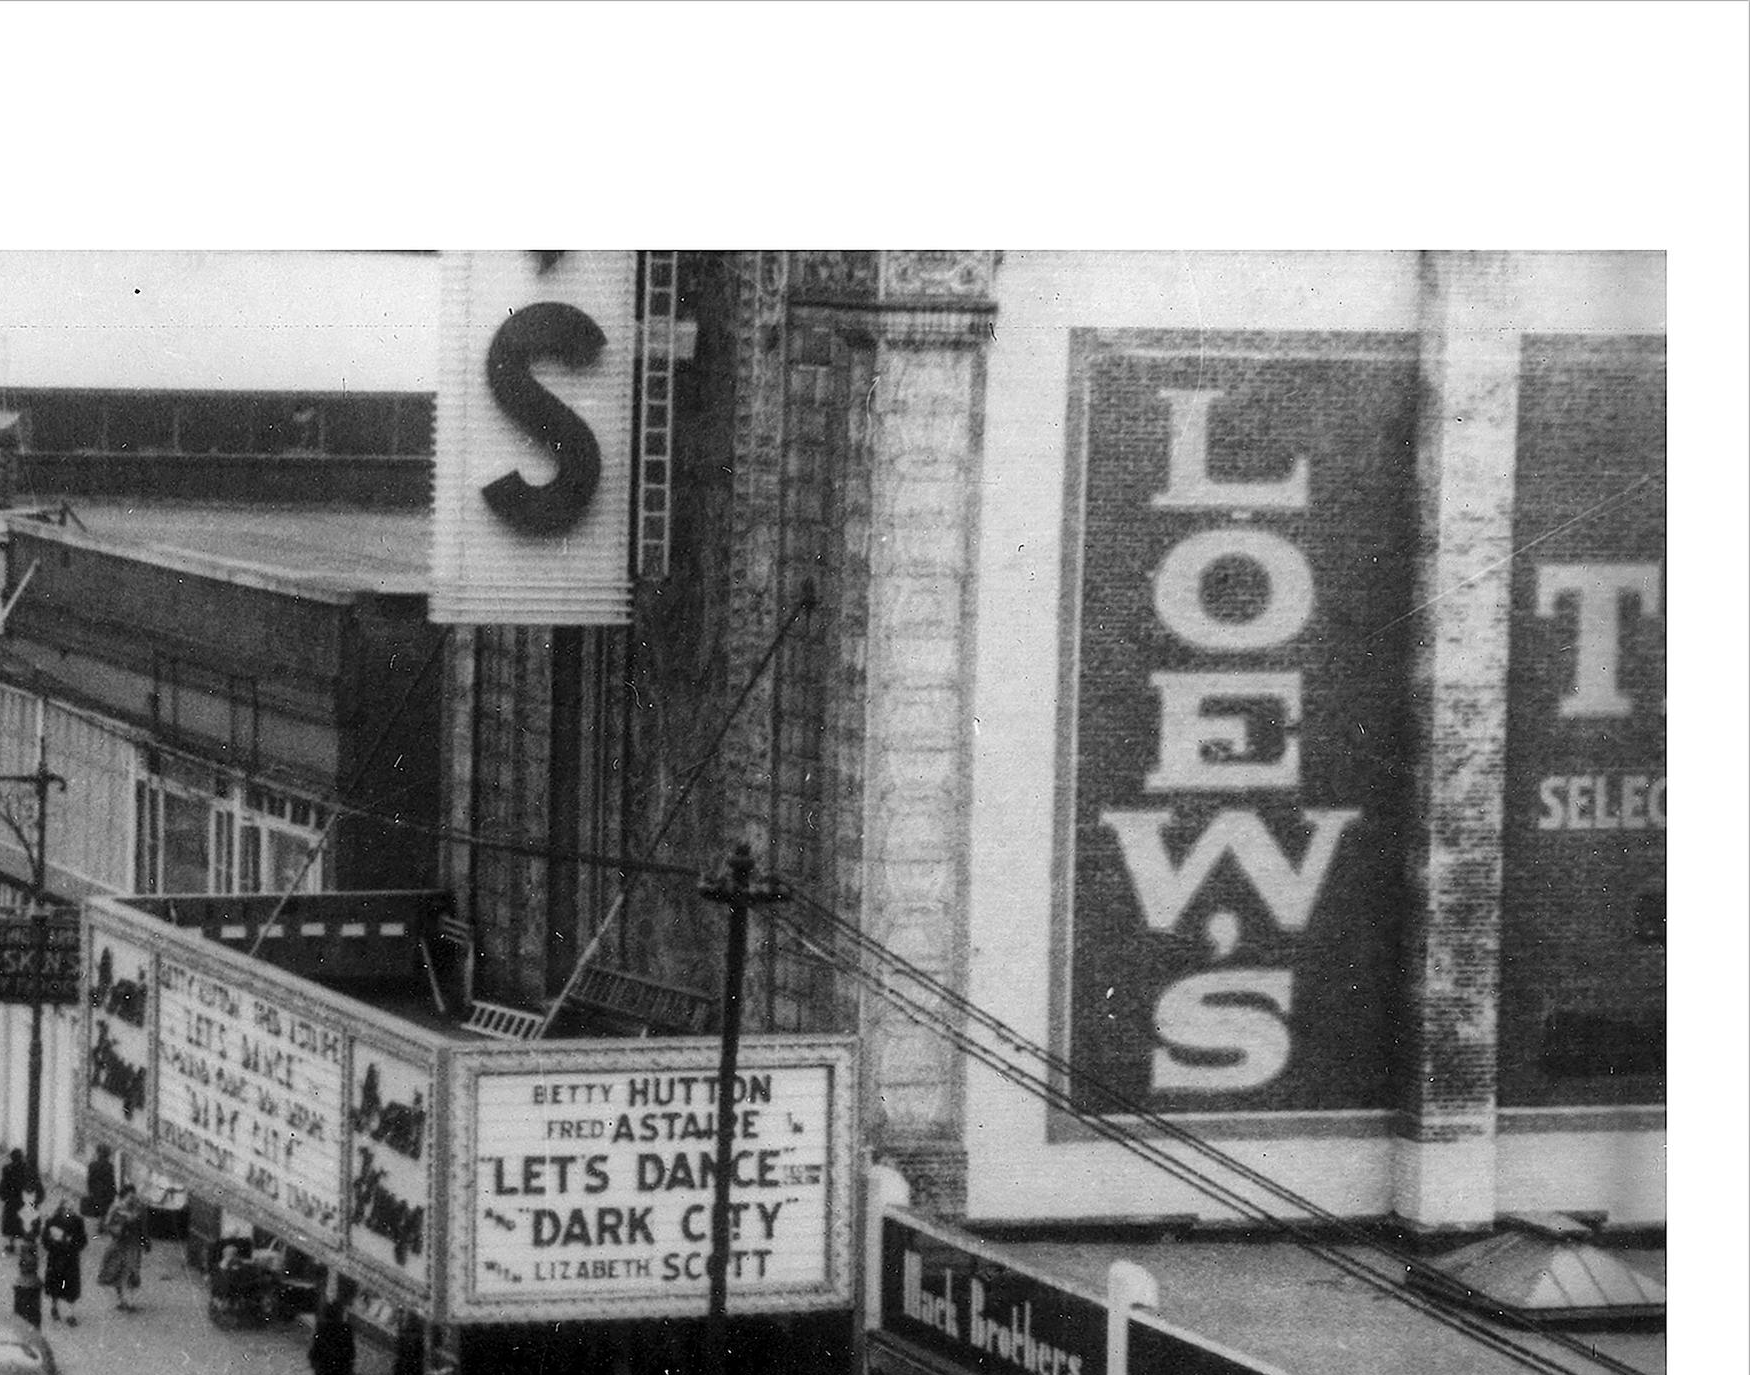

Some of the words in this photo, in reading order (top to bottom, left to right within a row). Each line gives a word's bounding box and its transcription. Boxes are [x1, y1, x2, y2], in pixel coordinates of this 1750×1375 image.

[1099, 389, 1362, 1093] LOEW'S
[533, 1083, 613, 1105] BETTY
[629, 1073, 772, 1107] HUTTON
[547, 1119, 604, 1140] FRED
[681, 1197, 799, 1242] CTY"
[535, 1256, 652, 1281] LIZABETH
[661, 1248, 773, 1281] SCTT
